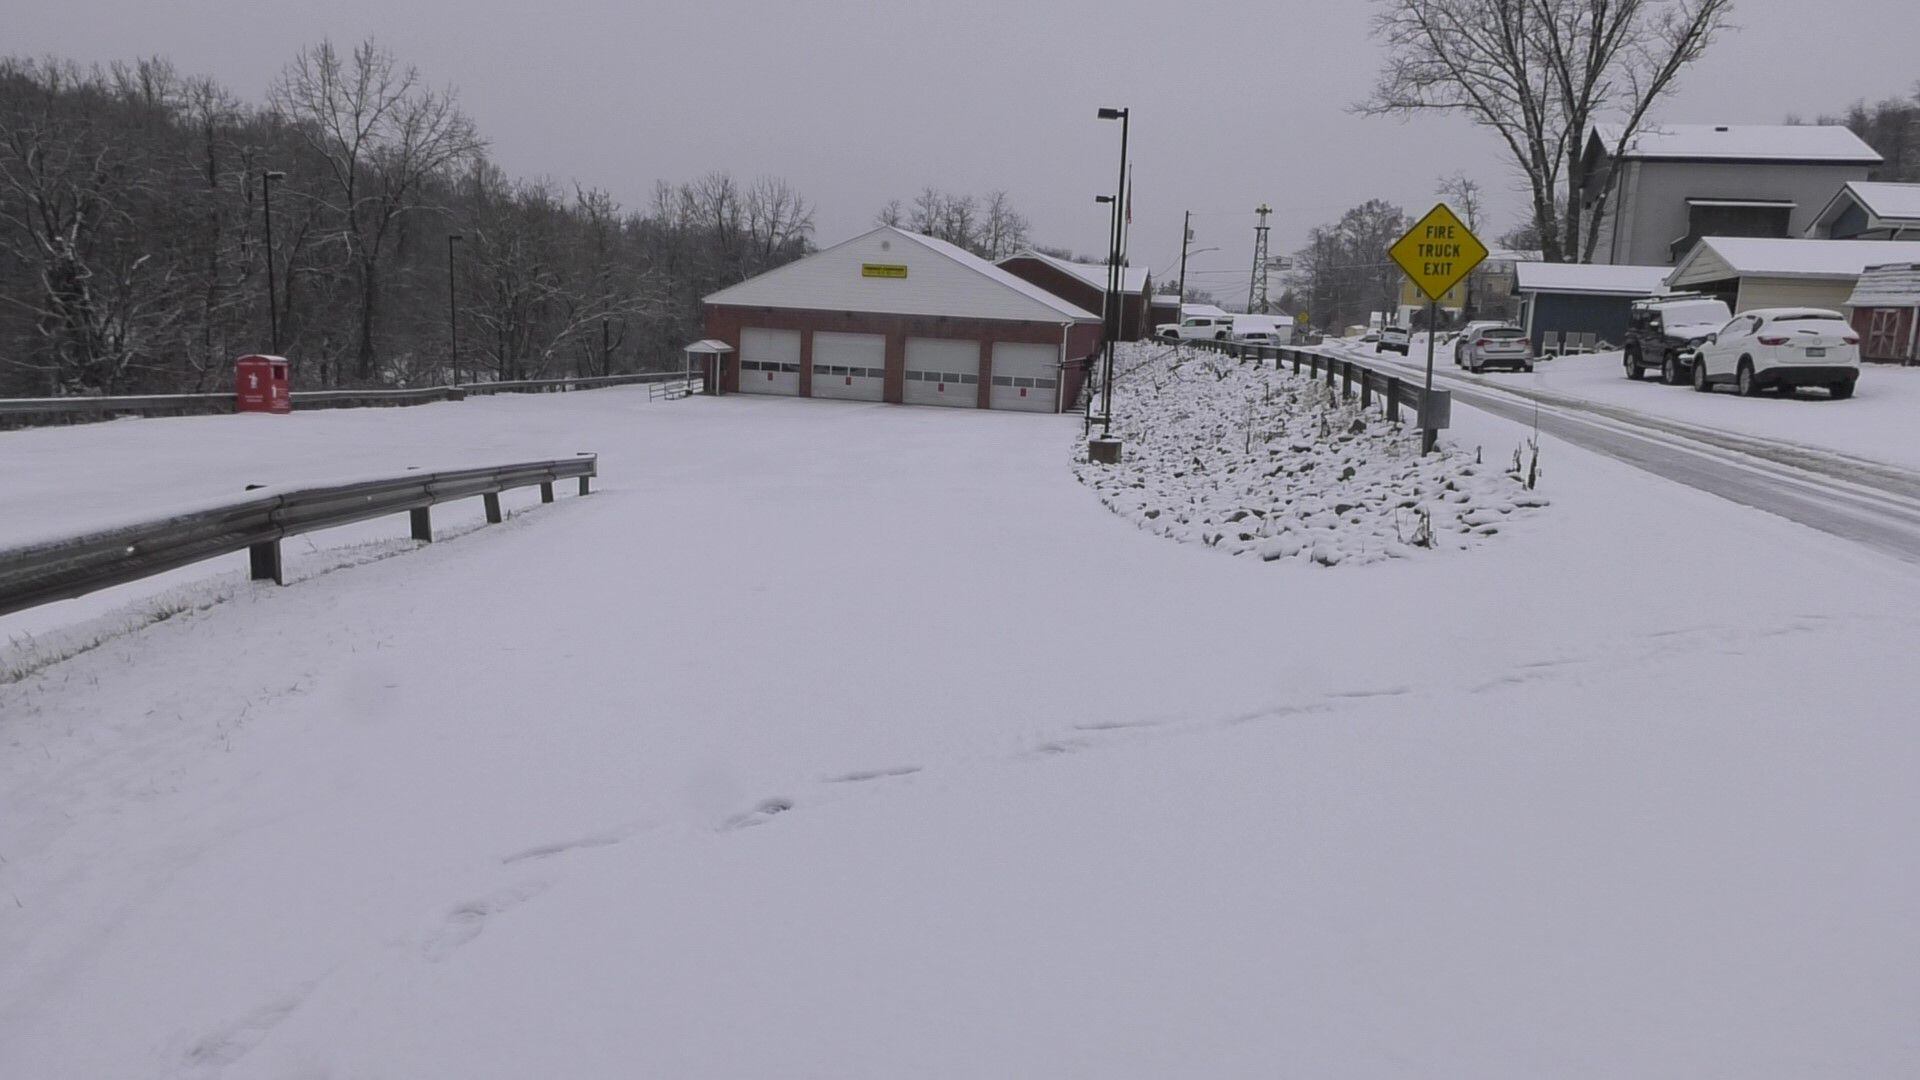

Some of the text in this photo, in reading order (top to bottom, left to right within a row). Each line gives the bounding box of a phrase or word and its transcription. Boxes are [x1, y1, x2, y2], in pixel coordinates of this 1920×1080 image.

[1426, 225, 1454, 239] FIRE
[1418, 244, 1460, 257] TRUCK
[1424, 262, 1453, 276] EXIT
